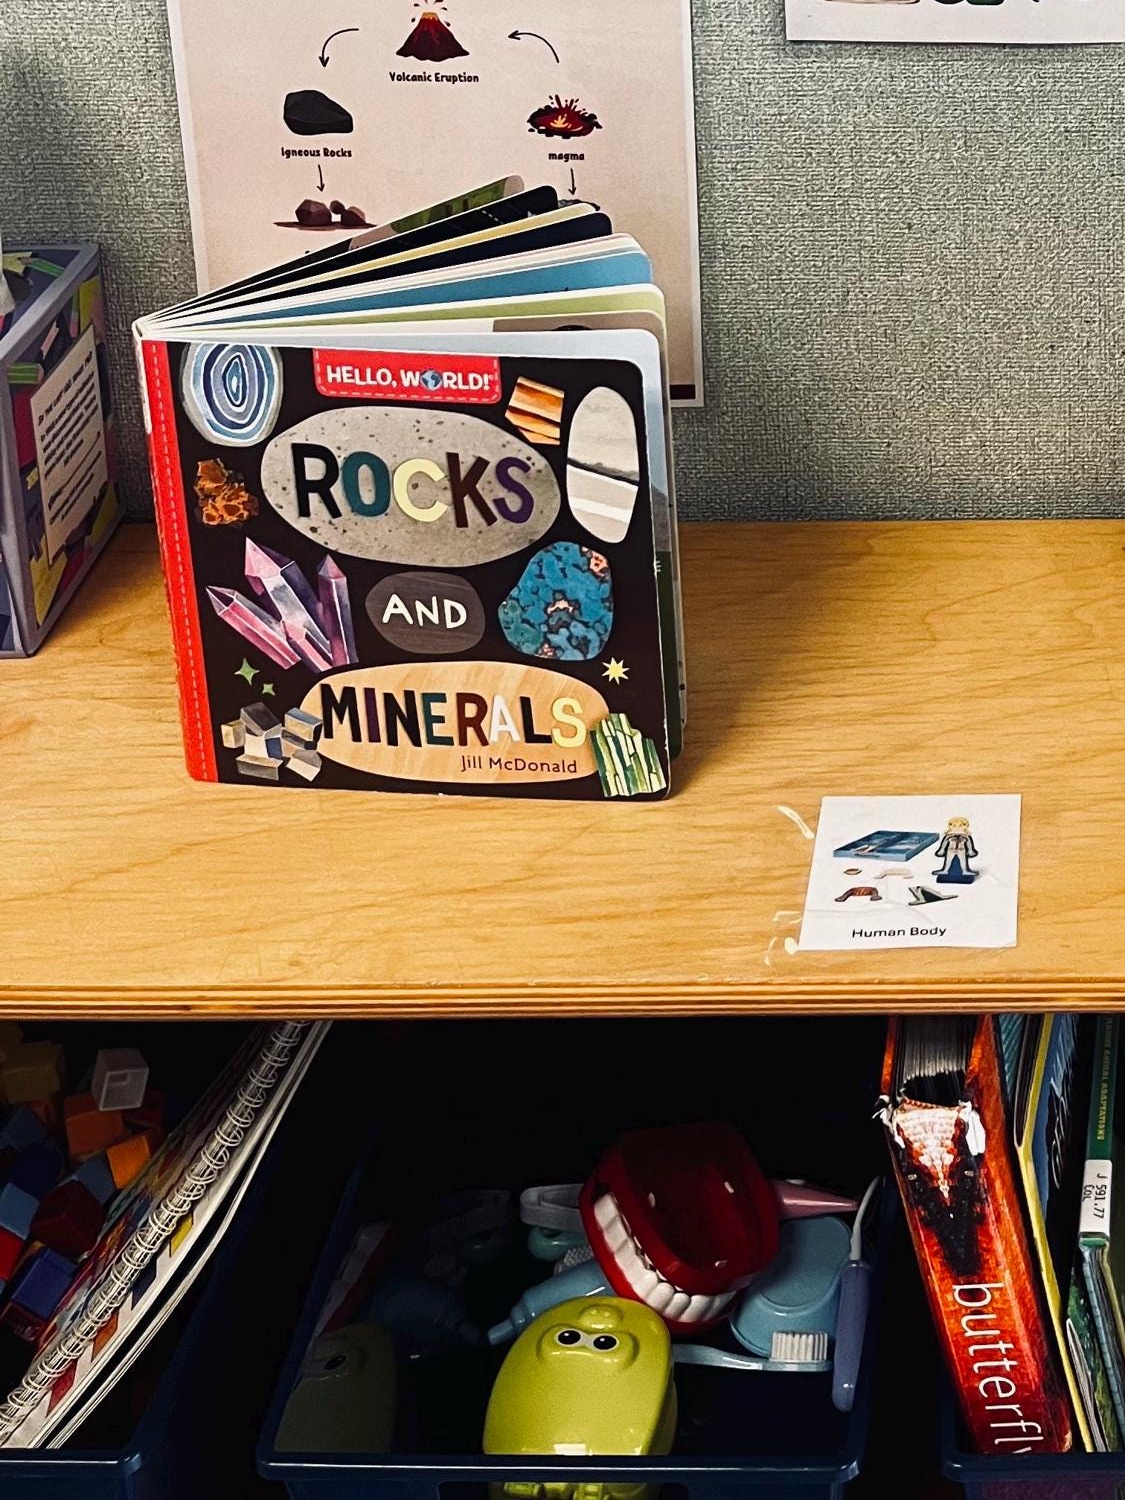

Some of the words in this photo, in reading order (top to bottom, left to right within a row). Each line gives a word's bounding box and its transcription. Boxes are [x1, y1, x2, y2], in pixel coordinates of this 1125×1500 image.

[388, 71, 433, 82] Volcanic
[434, 71, 479, 85] Eruption
[281, 146, 321, 159] Igneous
[322, 147, 353, 158] Rocks
[548, 152, 585, 163] magma
[326, 365, 398, 388] HELLO,
[291, 442, 535, 528] ROCKS
[382, 593, 467, 629] AND
[320, 684, 587, 750] MINERALS
[461, 755, 482, 772] Jill
[489, 757, 577, 773] McDonald
[852, 929, 906, 938] Human
[910, 926, 947, 937] Body
[1096, 1172, 1107, 1180] J
[1093, 1184, 1107, 1219] 591.77
